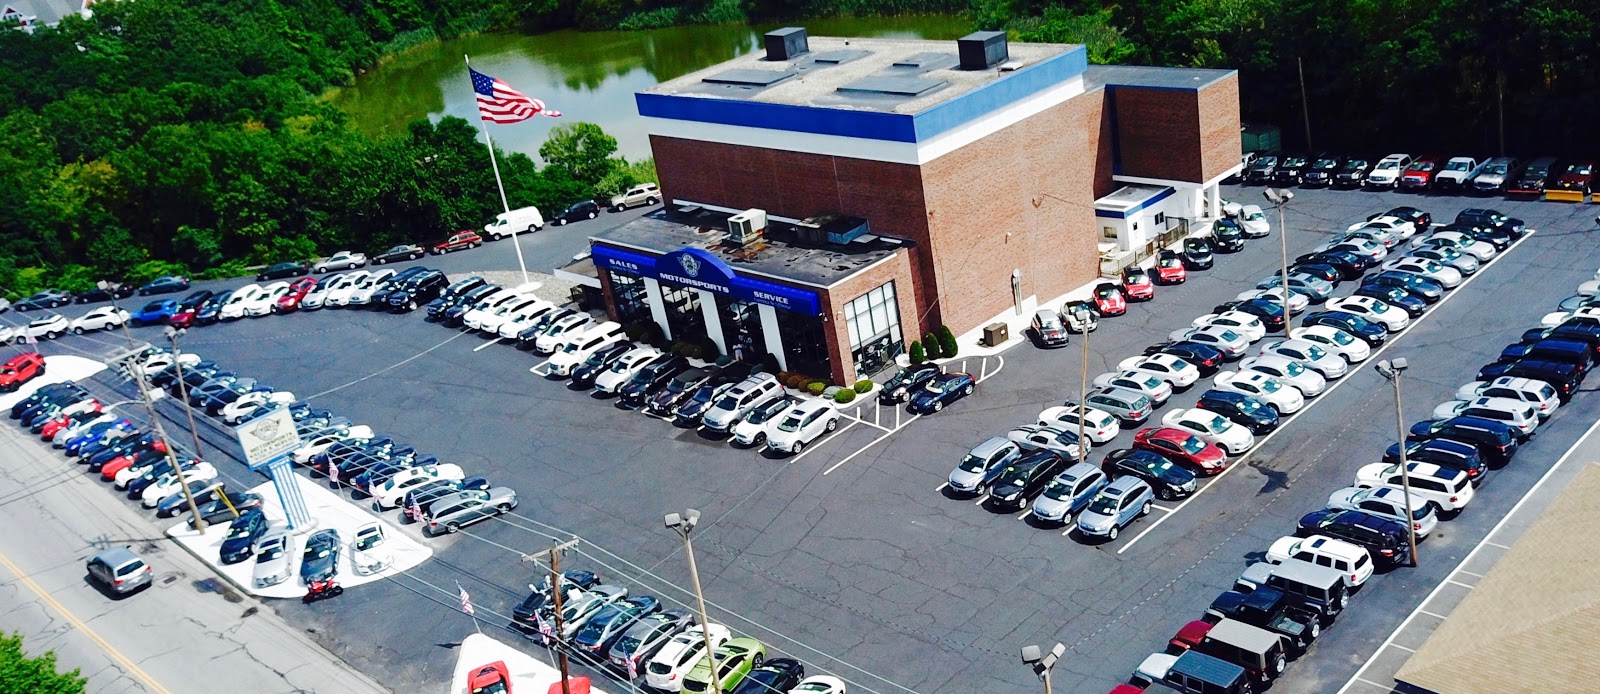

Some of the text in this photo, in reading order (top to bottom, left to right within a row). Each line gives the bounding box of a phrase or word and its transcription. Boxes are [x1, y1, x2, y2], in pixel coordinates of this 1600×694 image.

[609, 258, 638, 270] SALES
[659, 272, 730, 294] MOTORSPORTS
[753, 290, 789, 305] SERVICE
[249, 449, 268, 459] SALES
[274, 434, 297, 448] SERVICE
[250, 431, 293, 453] MOTORSPORTS
